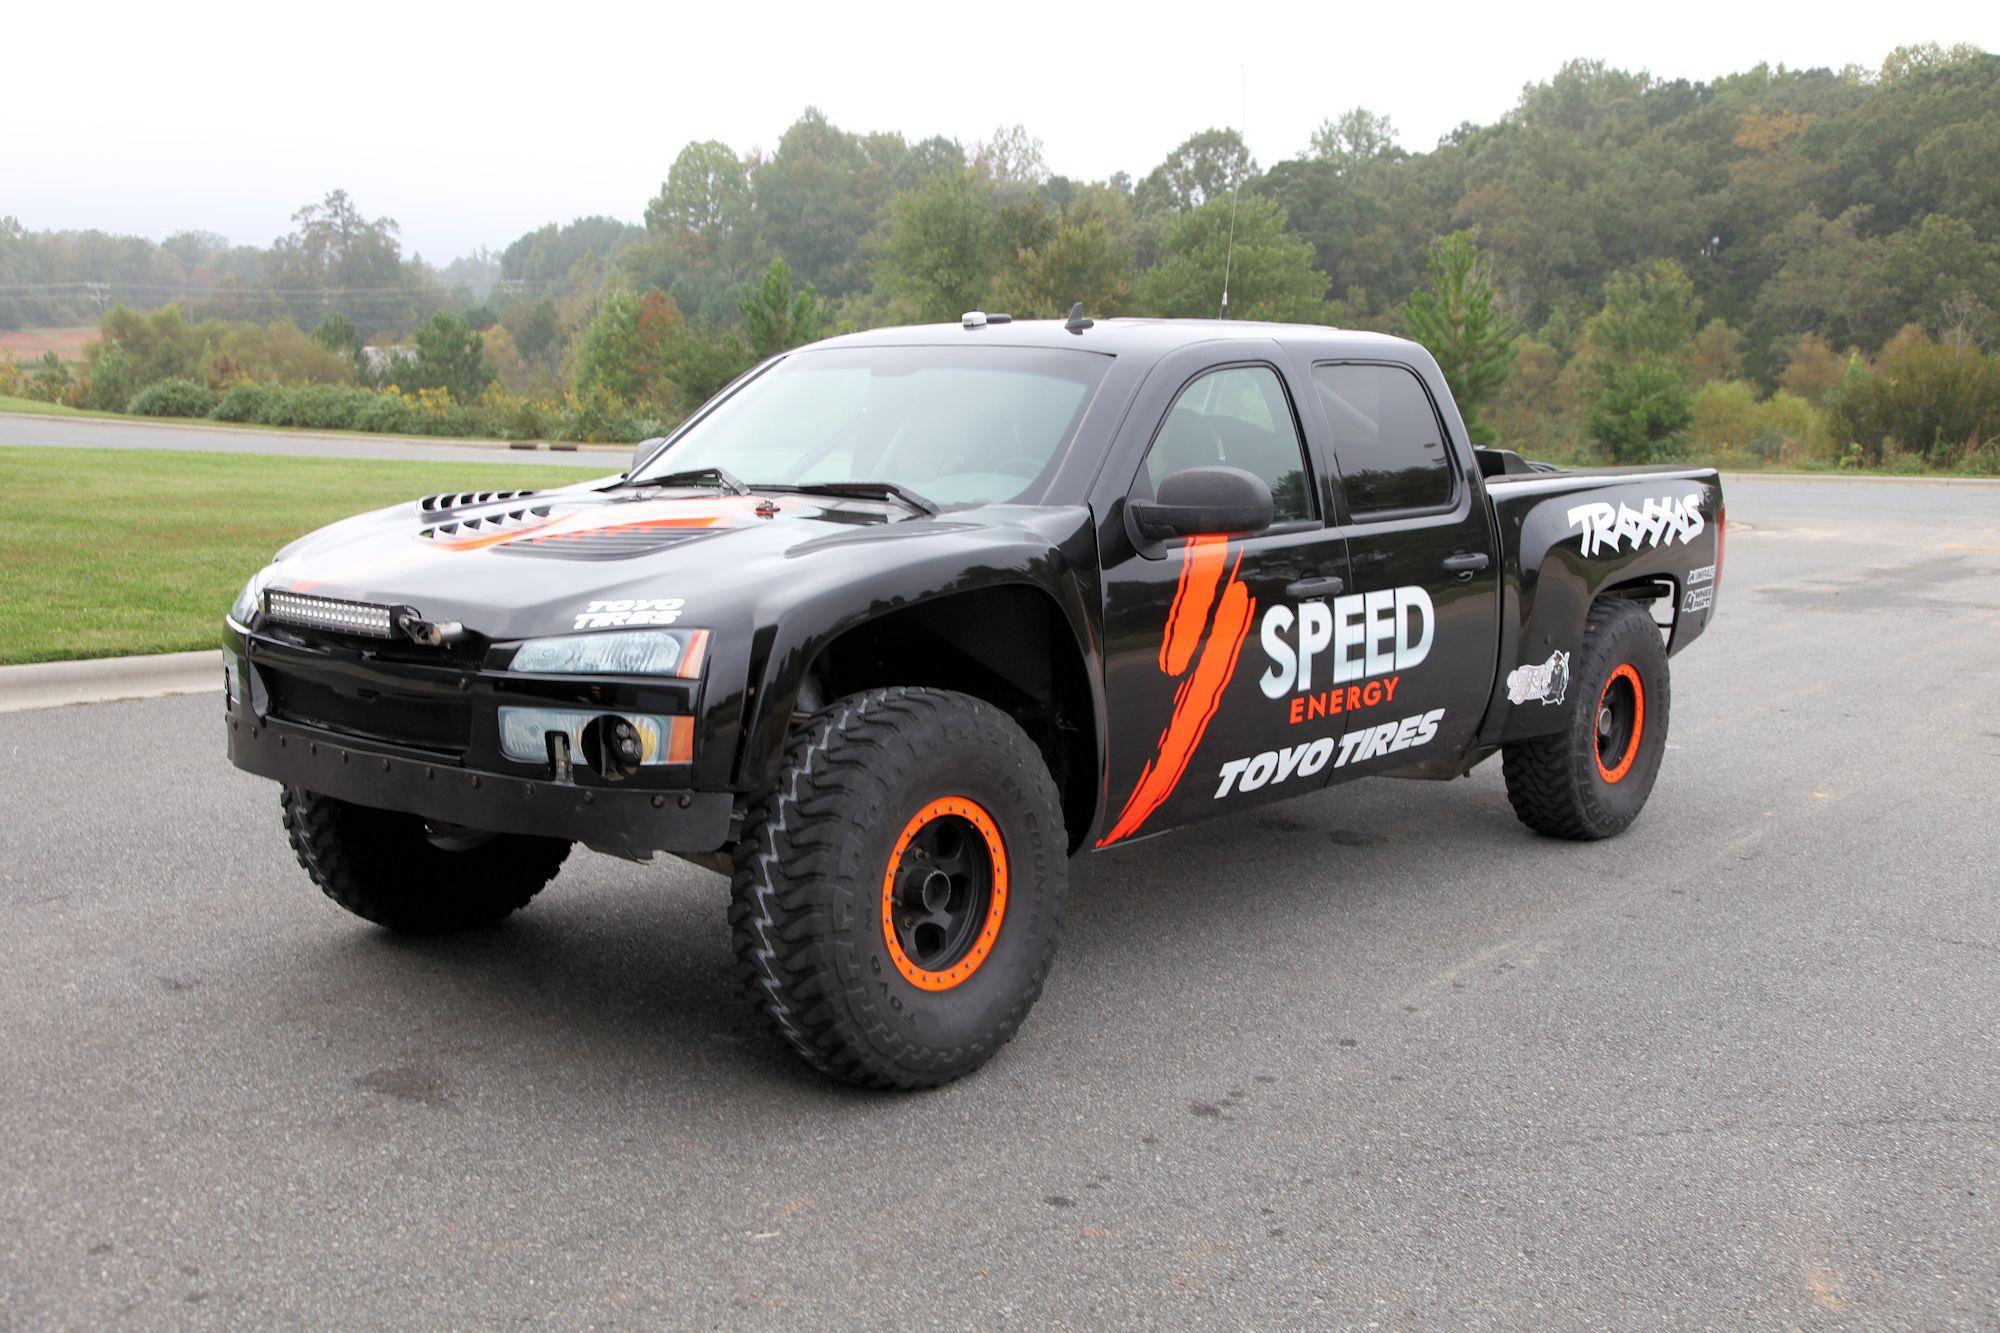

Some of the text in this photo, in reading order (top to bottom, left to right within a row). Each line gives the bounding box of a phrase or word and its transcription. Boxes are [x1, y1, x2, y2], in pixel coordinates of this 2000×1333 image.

[1567, 494, 1705, 558] TRAXXAS
[573, 610, 682, 630] TIRES
[587, 599, 686, 613] TOYO
[1260, 585, 1435, 699] SPEED
[1289, 676, 1399, 724] ENERGY
[1213, 708, 1445, 799] TOYO TIRES
[870, 954, 918, 1028] TOYO
